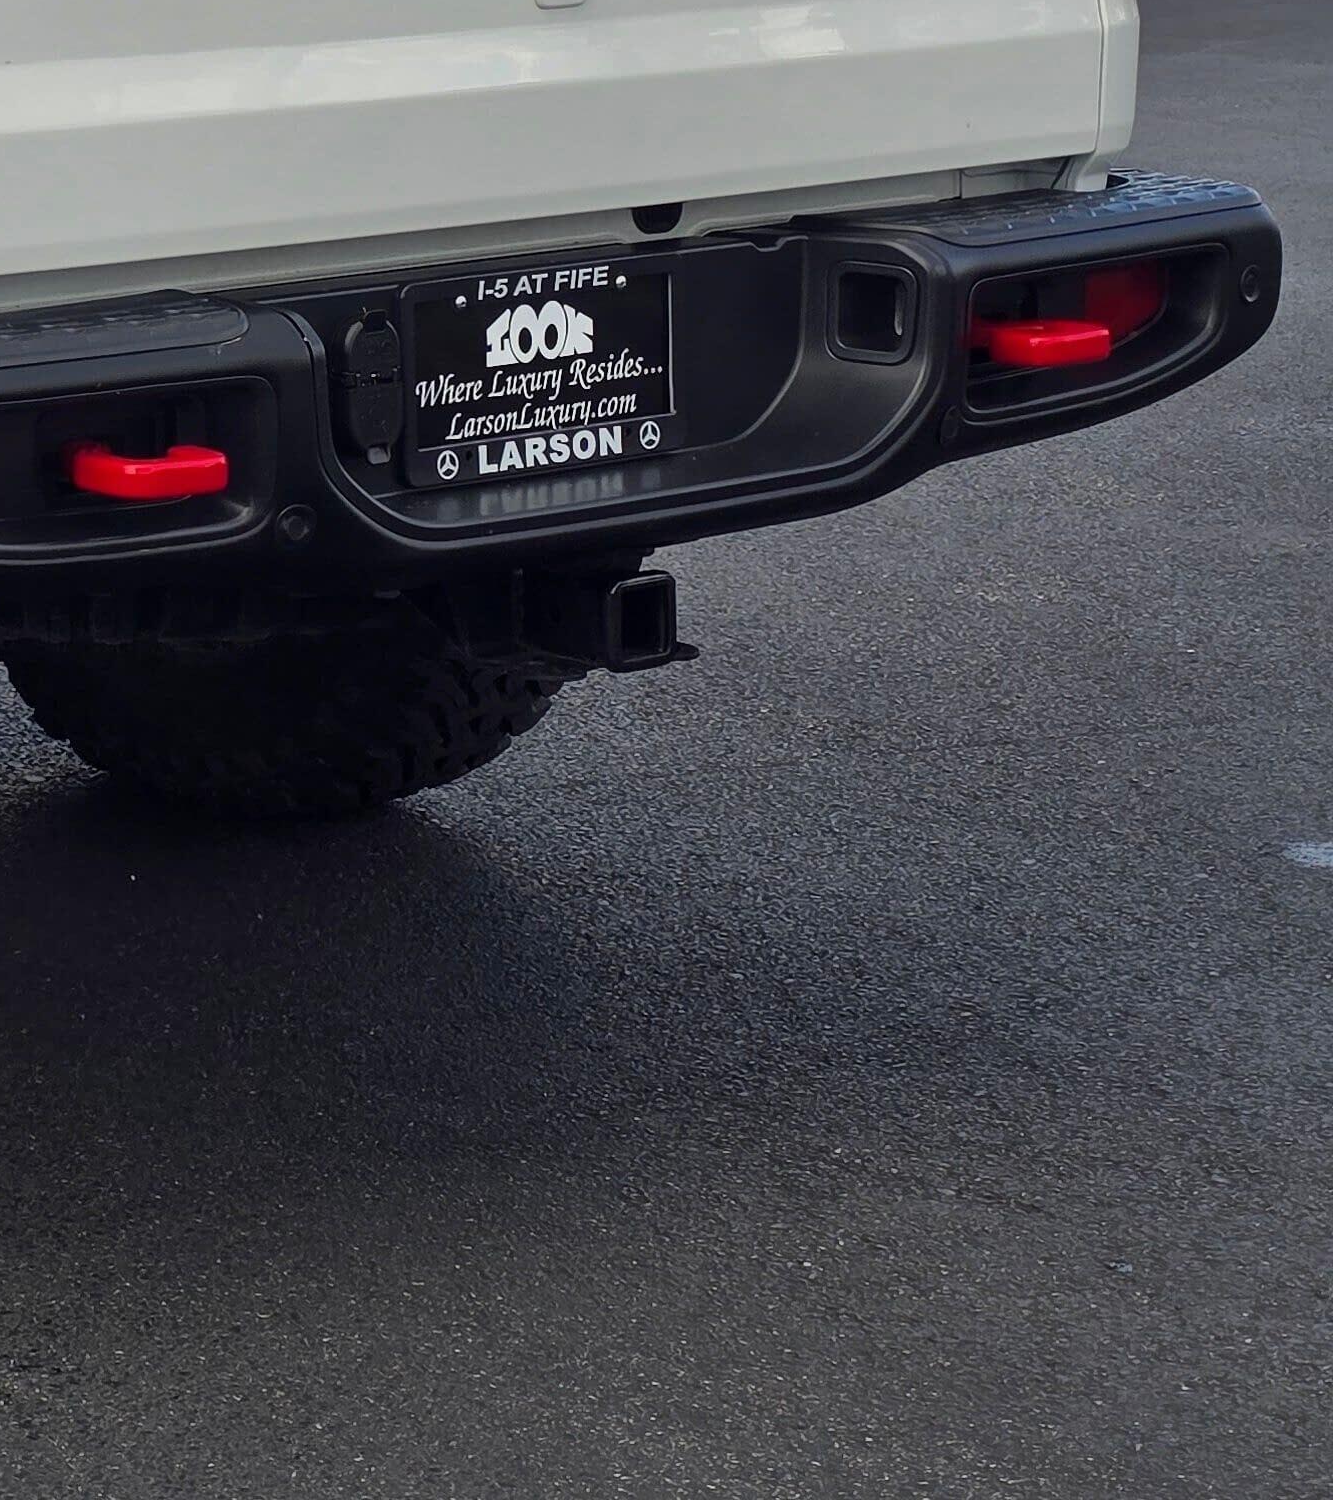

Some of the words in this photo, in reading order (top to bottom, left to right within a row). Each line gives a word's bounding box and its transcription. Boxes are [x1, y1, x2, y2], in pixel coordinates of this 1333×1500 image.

[477, 278, 509, 301] I-5
[513, 273, 549, 297] AT
[554, 265, 610, 292] FIFE
[486, 300, 594, 368] LOOK
[415, 373, 484, 408] Where
[487, 368, 563, 401] Luxury
[569, 347, 664, 390] Resides...
[444, 393, 638, 441] LarsonLuxury.com
[478, 425, 624, 475] LARSON
